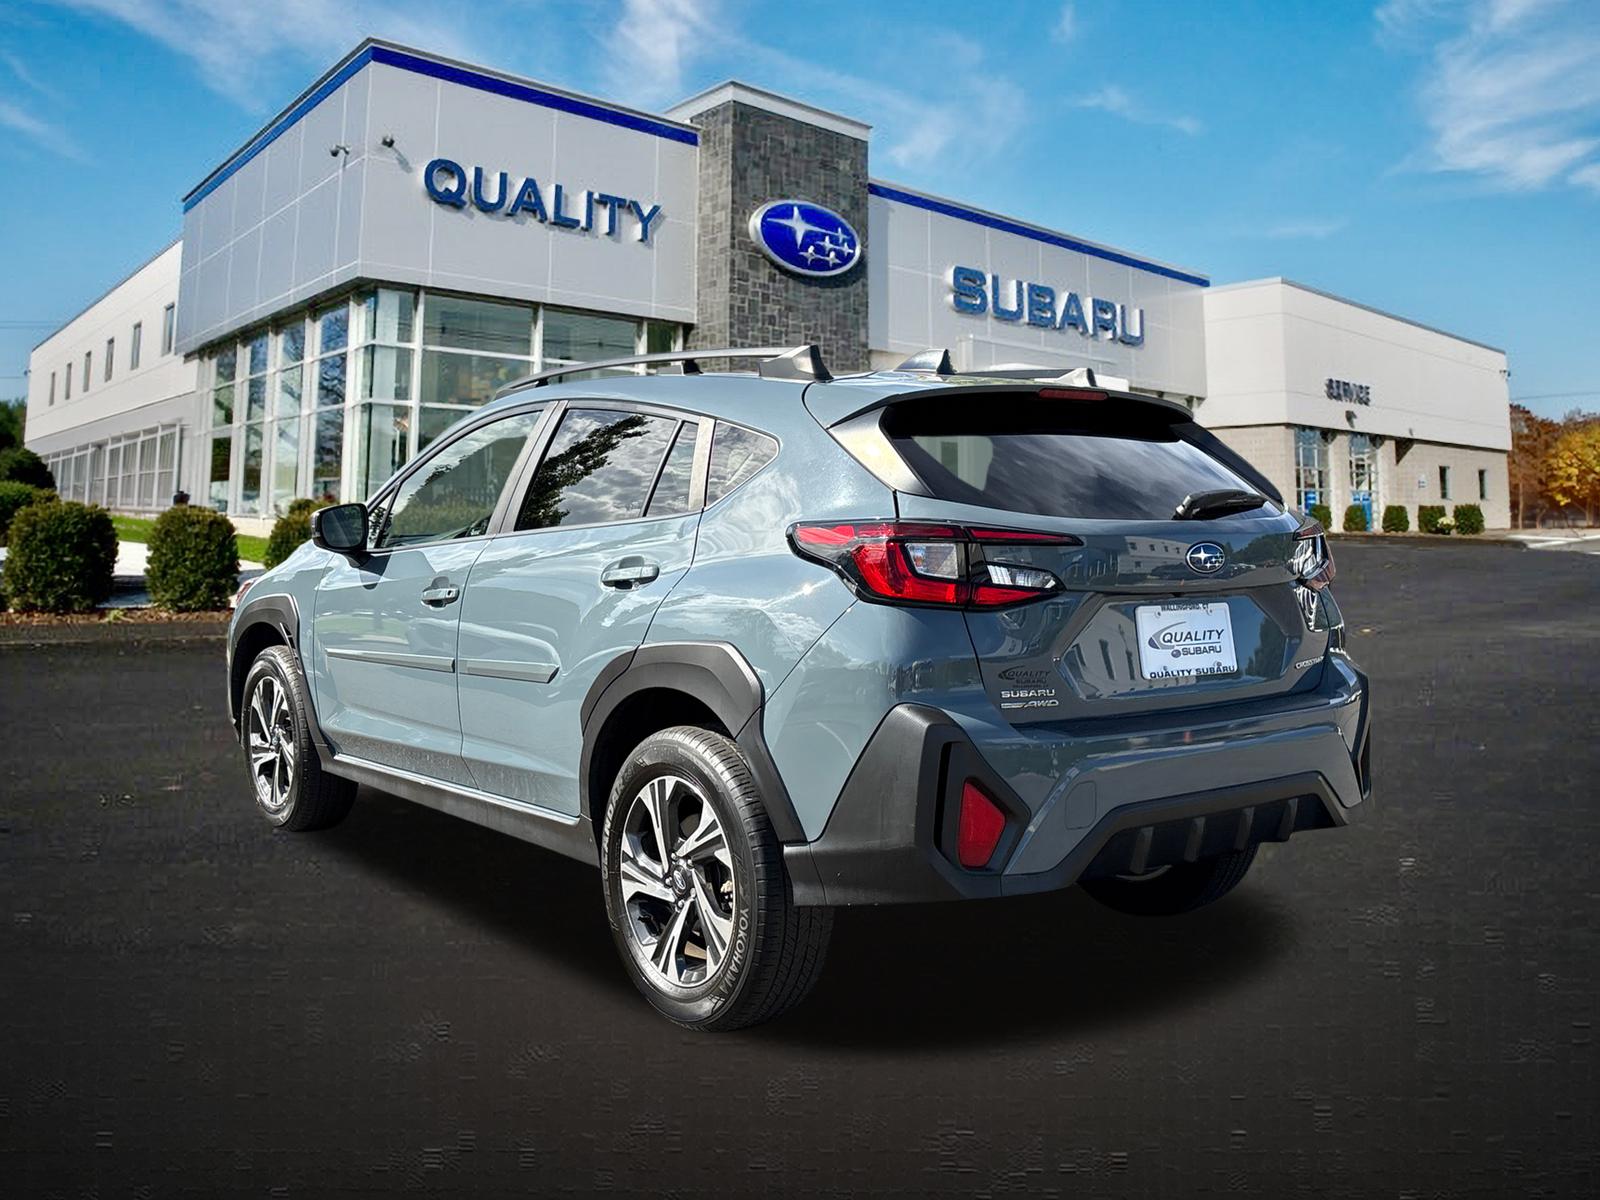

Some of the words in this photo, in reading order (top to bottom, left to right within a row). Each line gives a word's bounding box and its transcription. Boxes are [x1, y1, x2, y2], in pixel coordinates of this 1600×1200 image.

[424, 158, 661, 242] QUALITY
[951, 266, 1145, 347] SUBARU
[1325, 378, 1370, 406] SERVICE
[1162, 629, 1224, 643] QUALITY
[1181, 646, 1222, 656] SUBARU
[1149, 668, 1192, 679] QUALITY
[1195, 665, 1235, 675] SUBARU
[1001, 689, 1055, 698] SUBARU
[1024, 699, 1059, 708] AWD
[720, 907, 750, 996] YOKOHAMA
